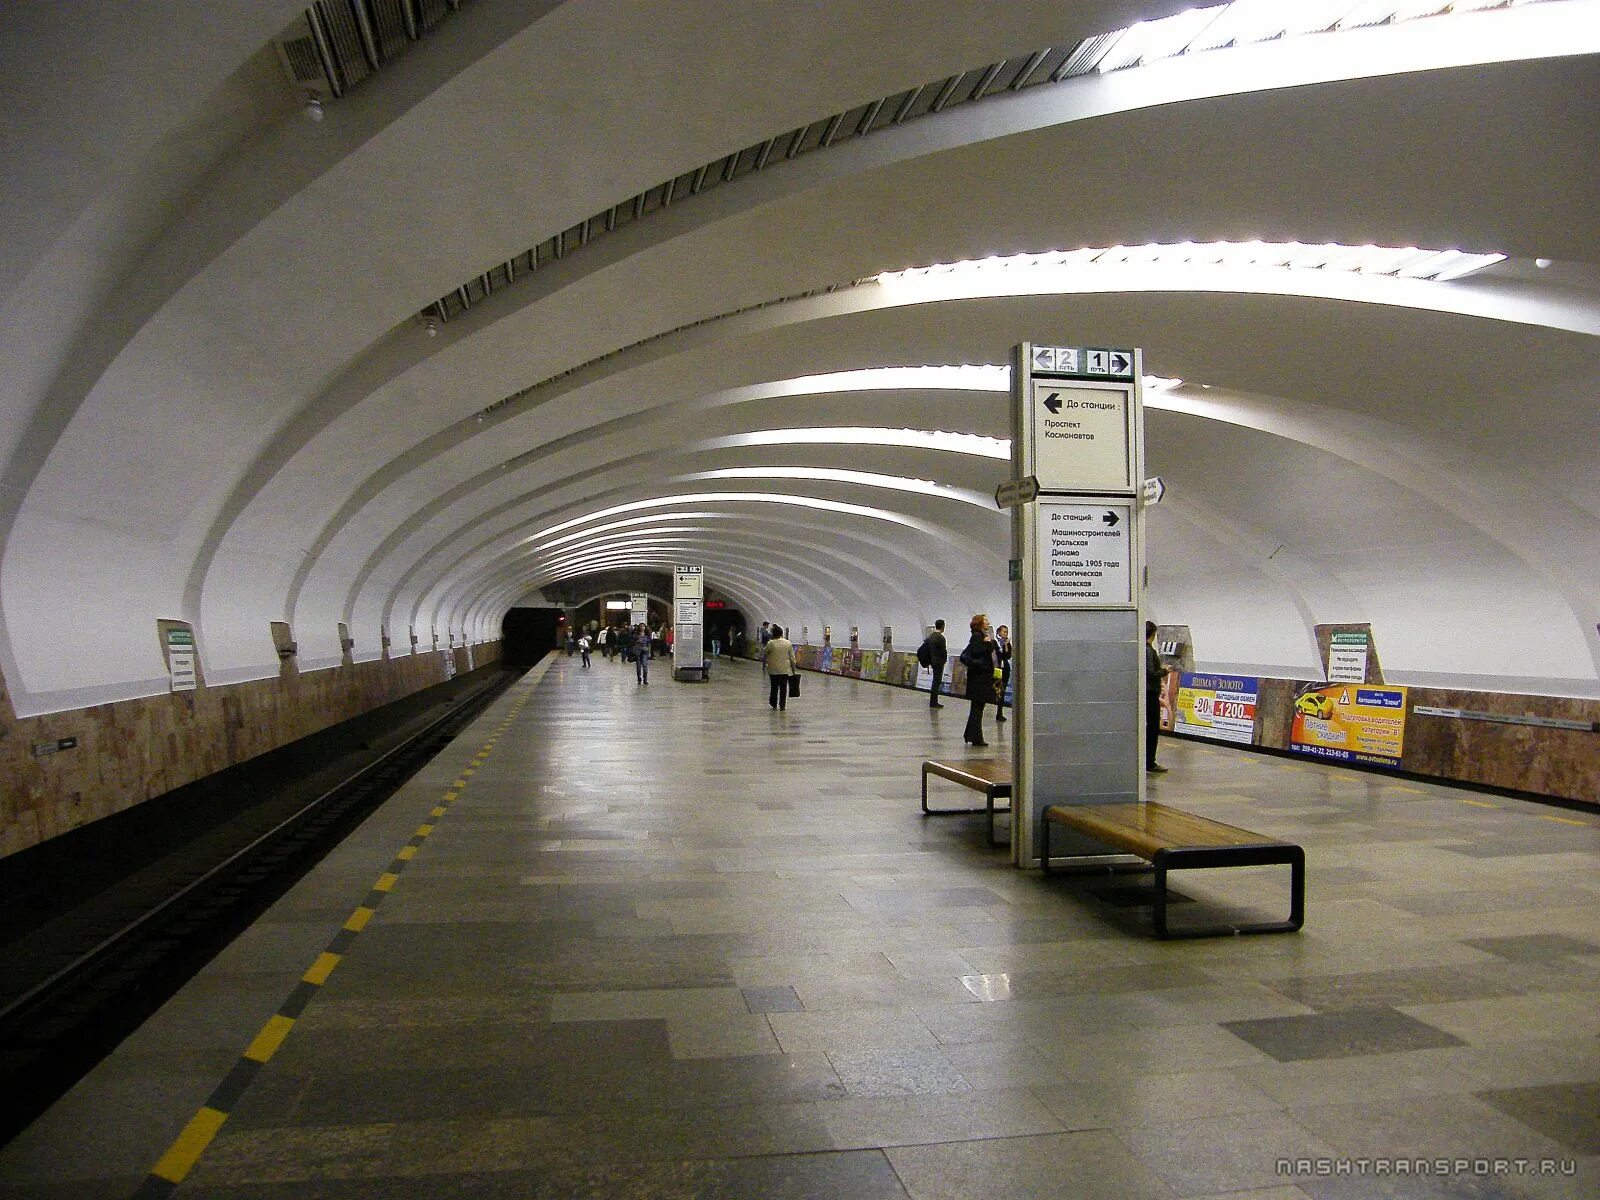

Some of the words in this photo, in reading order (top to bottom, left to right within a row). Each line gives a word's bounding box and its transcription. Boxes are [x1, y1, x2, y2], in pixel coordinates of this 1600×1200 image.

[1060, 350, 1072, 365] 2
[1093, 353, 1102, 367] 1
[1066, 399, 1079, 409] До
[1081, 402, 1116, 411] станции
[1044, 419, 1081, 429] Проспект
[1044, 430, 1095, 440] Космонавтов
[1051, 513, 1062, 521] До
[1062, 514, 1094, 522] станций:
[1051, 528, 1121, 538] Машиностроителей
[1051, 539, 1089, 547] Уральская
[1051, 549, 1080, 557] Динамо
[1051, 559, 1084, 568] Площадь
[1085, 559, 1103, 568] 1905
[1103, 560, 1120, 568] года
[1051, 569, 1103, 578] Геологическая
[1051, 580, 1092, 588] Чкаловская
[1051, 590, 1100, 599] Ботаническая
[1217, 678, 1244, 691] ЗОЛОТО
